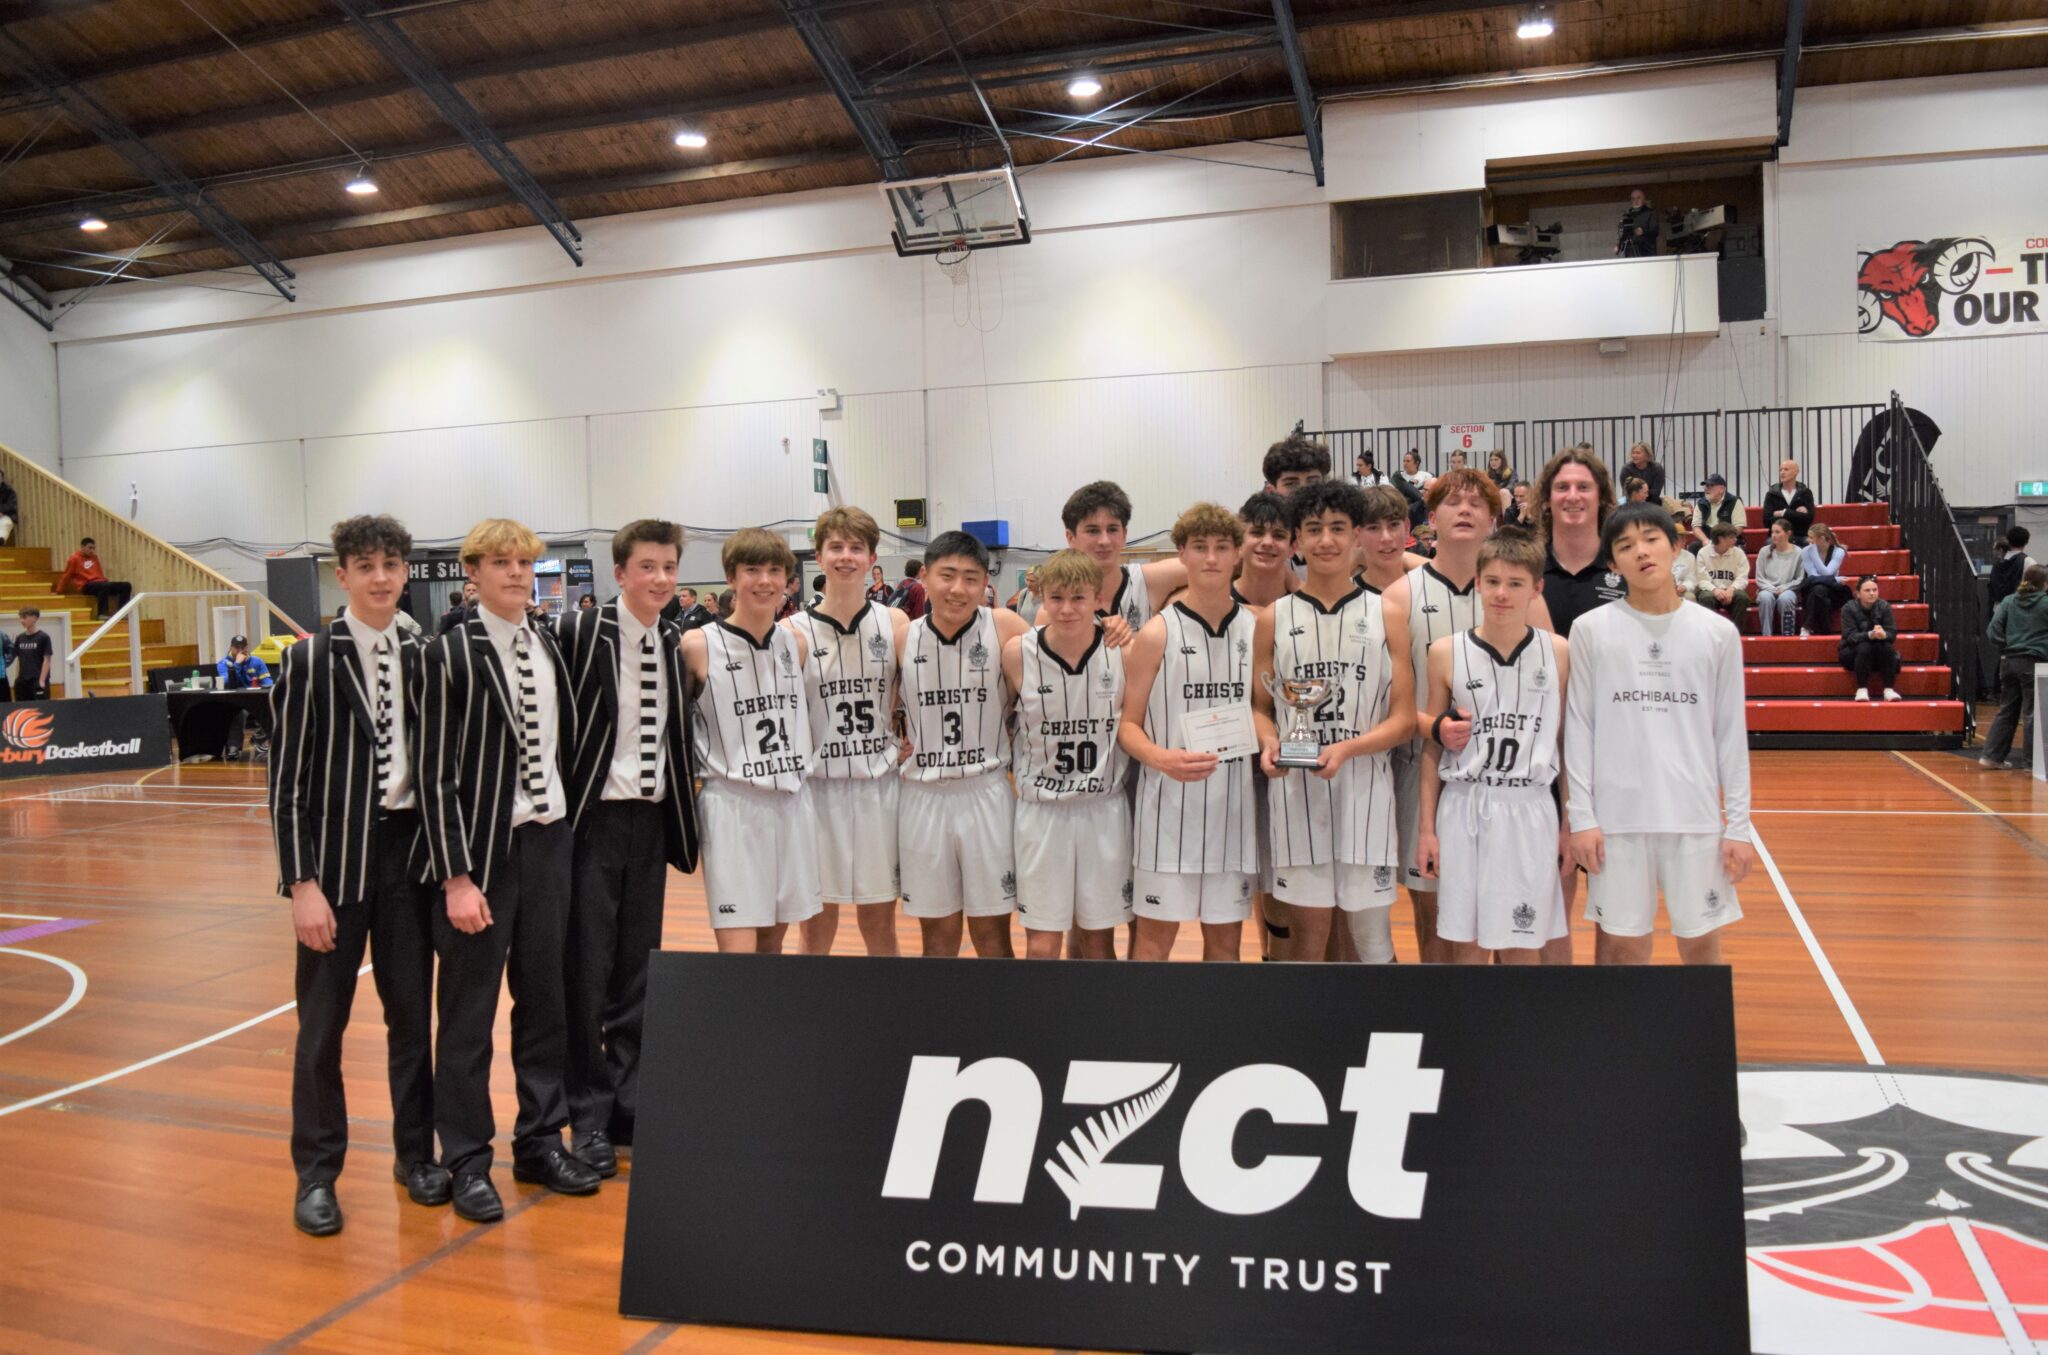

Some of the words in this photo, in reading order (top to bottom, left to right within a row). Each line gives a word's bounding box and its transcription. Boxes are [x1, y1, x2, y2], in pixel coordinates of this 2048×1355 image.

[2020, 252, 2048, 285] T
[1953, 290, 2041, 326] OUR
[1450, 425, 1485, 434] SECTION
[1462, 434, 1473, 448] 6
[408, 563, 430, 579] HE
[819, 677, 886, 699] CHRIST'S
[917, 687, 988, 707] CHRIST'S
[1612, 690, 1699, 705] ARCHIBALDS
[836, 700, 875, 736] 35
[943, 711, 962, 746] 3
[1040, 718, 1115, 736] CHRIST'S
[755, 717, 791, 755] 24
[916, 747, 986, 768] COLLEGE
[1054, 741, 1098, 775] 50
[1482, 737, 1520, 773] 10
[881, 1032, 1444, 1222] nzct
[905, 1240, 1201, 1287] COMMUNITY
[1230, 1253, 1392, 1294] TRUST
